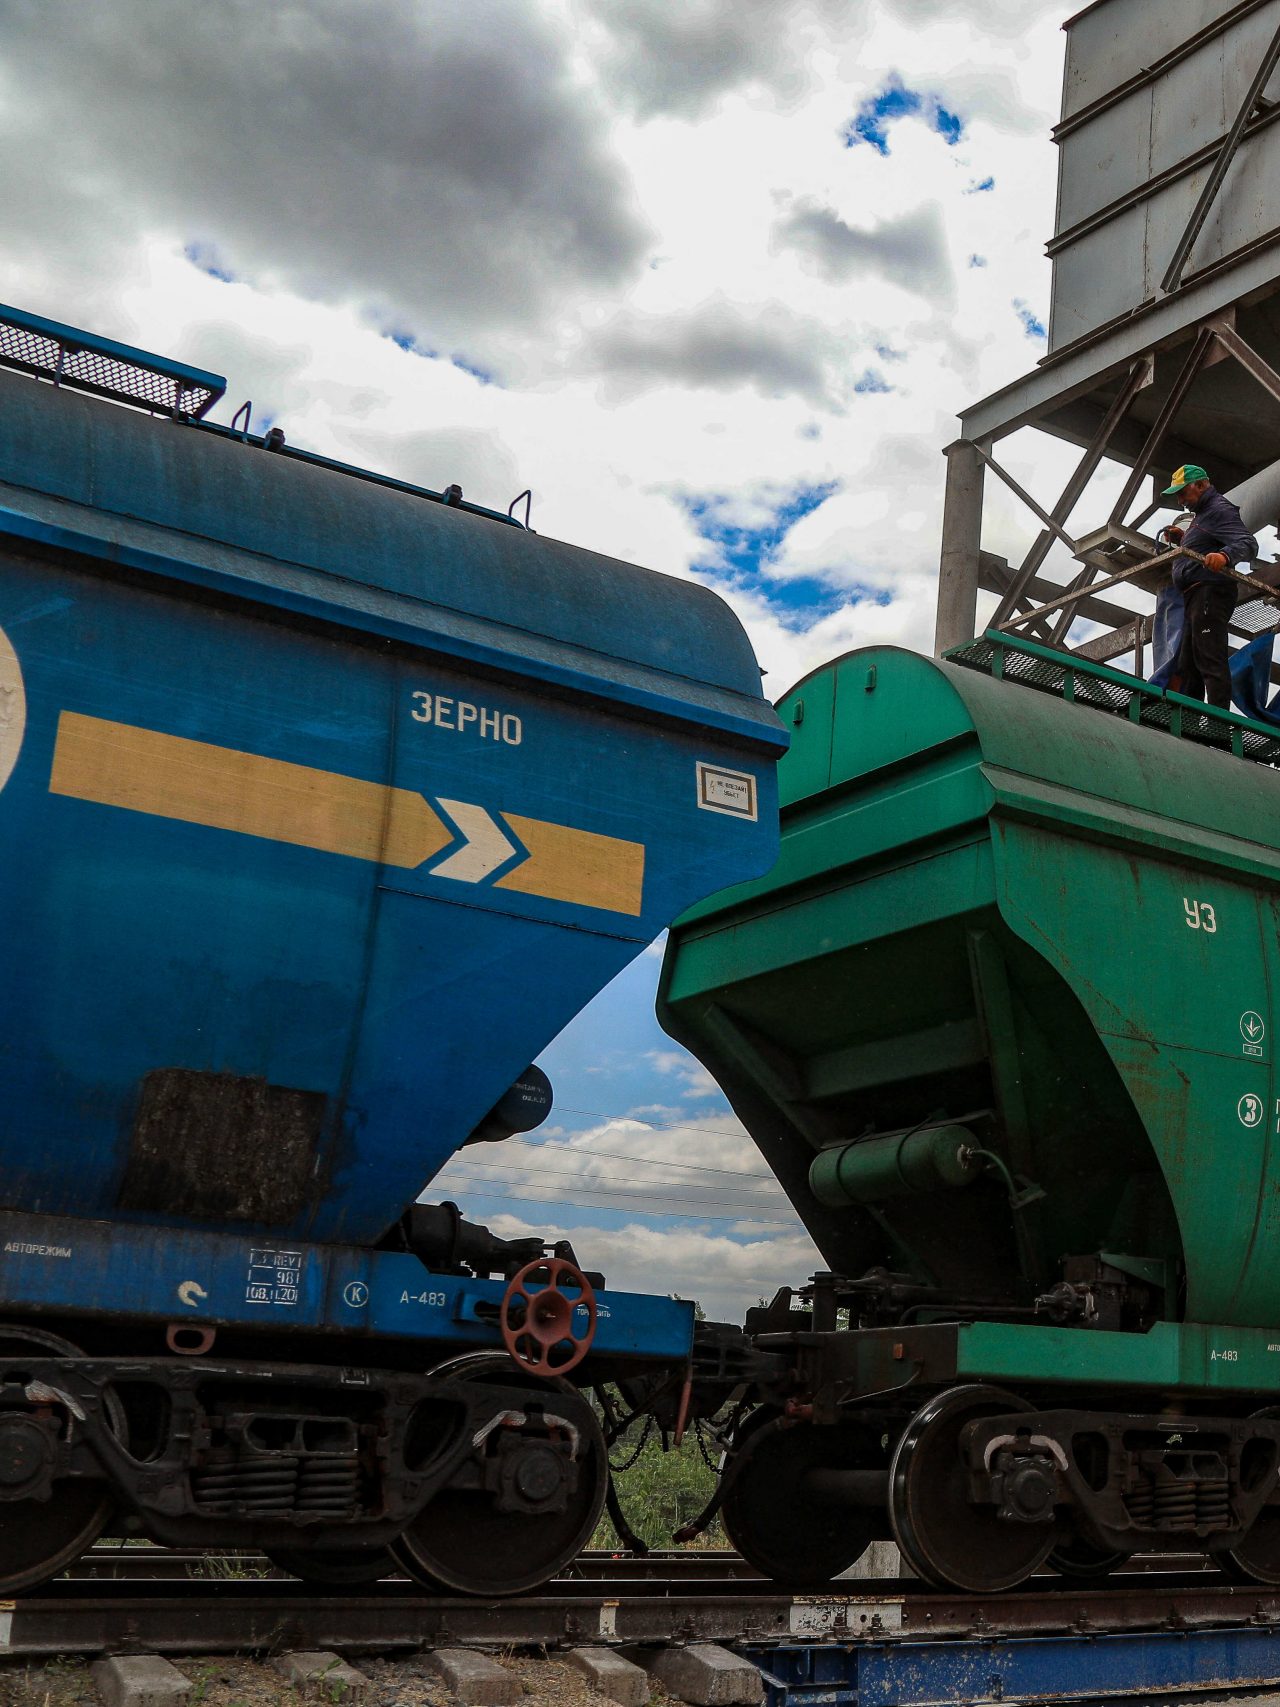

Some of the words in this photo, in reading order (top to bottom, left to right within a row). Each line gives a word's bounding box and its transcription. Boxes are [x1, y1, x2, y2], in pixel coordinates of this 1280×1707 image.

[411, 691, 522, 746] ЗЕРНО
[1183, 897, 1217, 933] УЗ
[4, 1242, 72, 1258] АВТОРЕЖИМ
[273, 1255, 296, 1267] REV
[276, 1271, 294, 1285] 98
[400, 1289, 446, 1307] А-483
[1211, 1349, 1238, 1362] А-483
